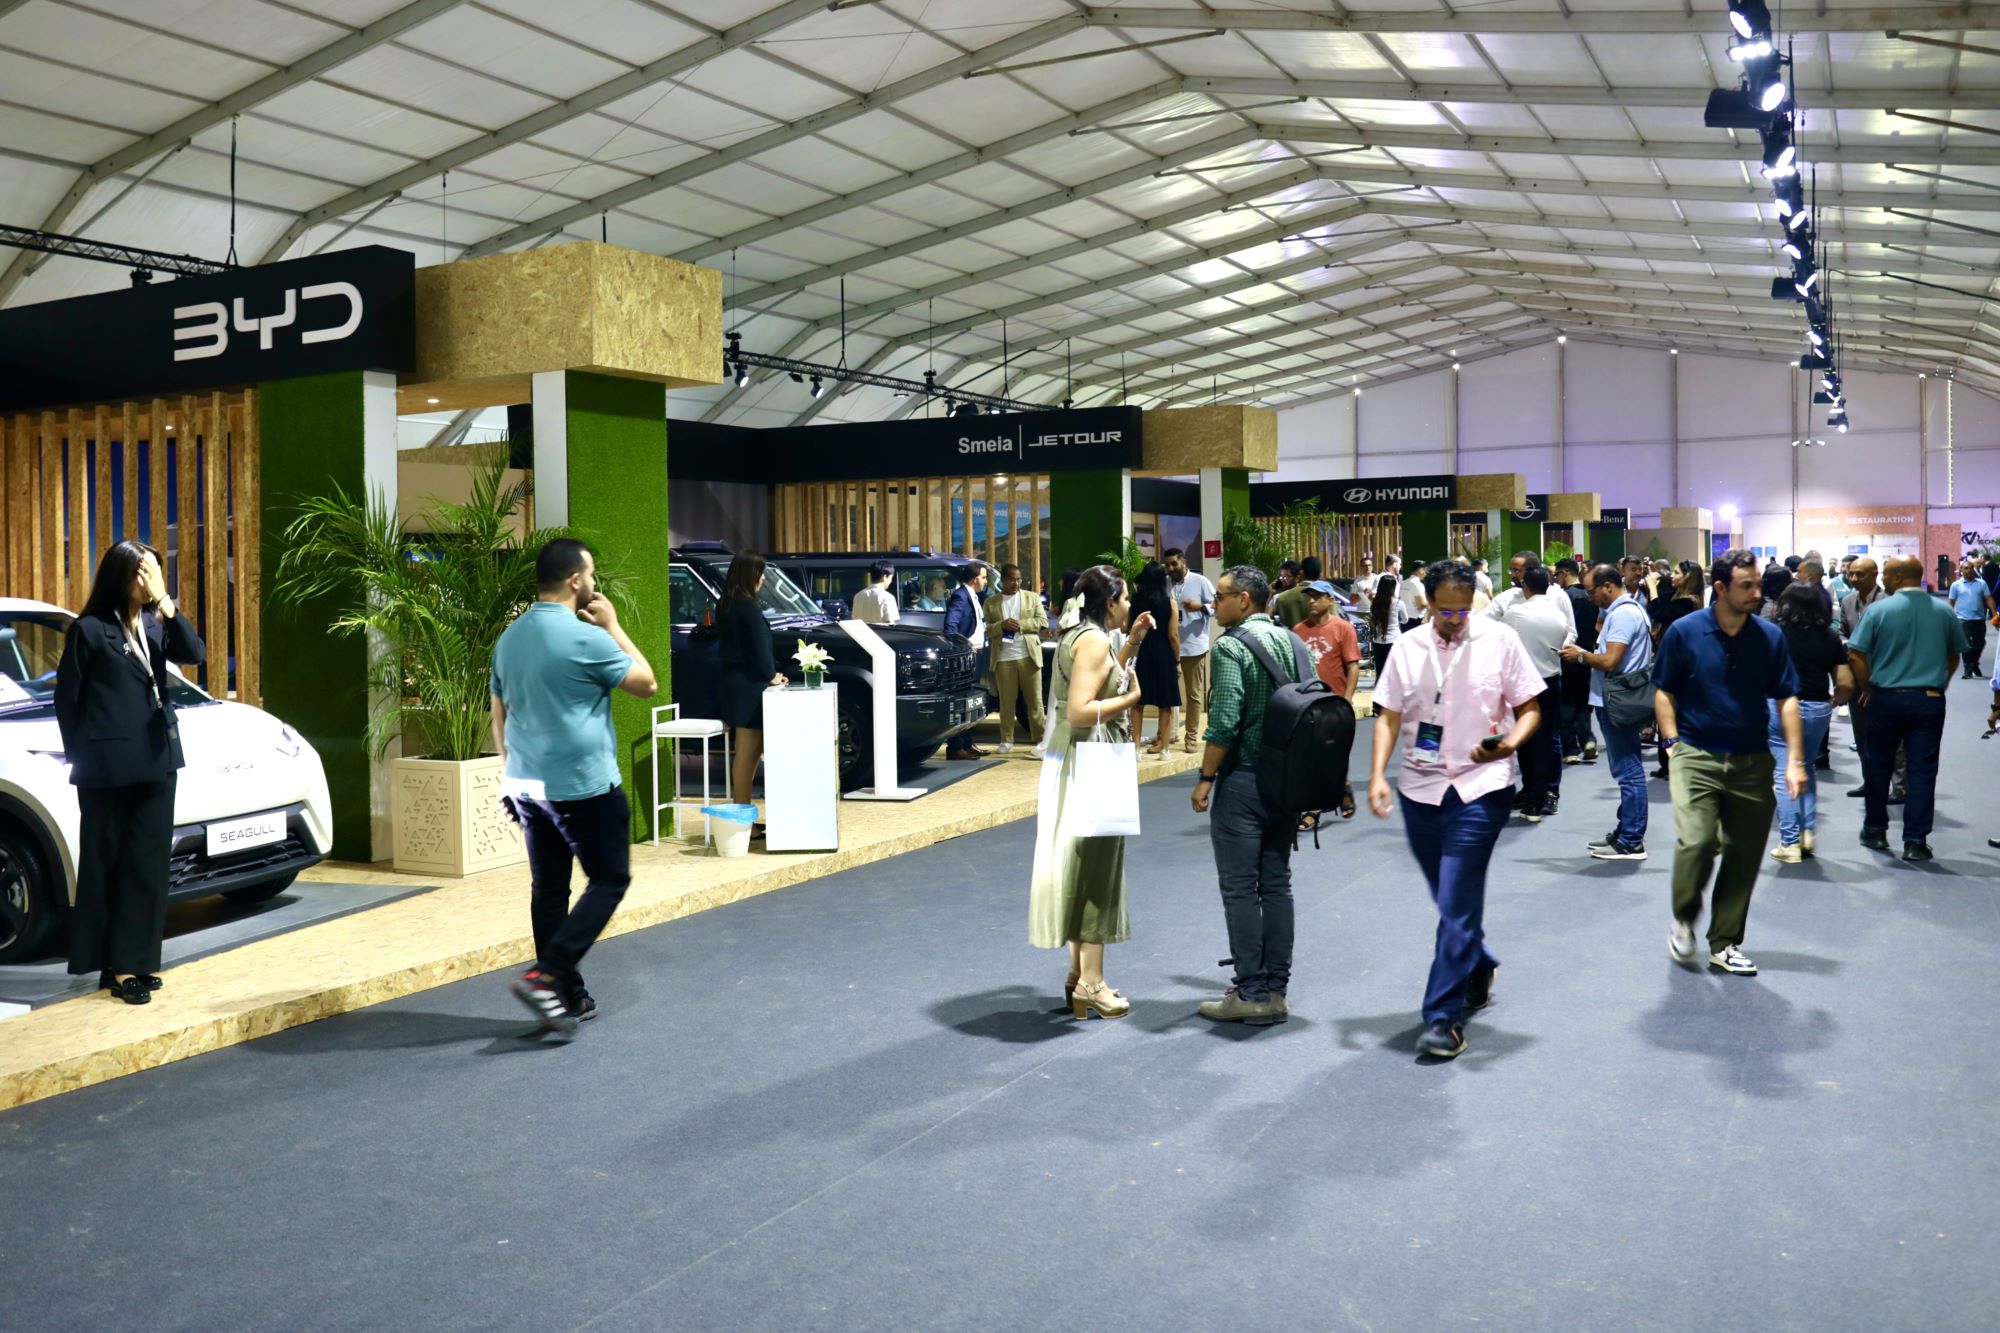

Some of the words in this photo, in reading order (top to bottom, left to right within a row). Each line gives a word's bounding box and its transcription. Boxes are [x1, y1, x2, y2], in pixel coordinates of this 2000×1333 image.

[174, 281, 363, 361] BYD
[958, 436, 1013, 453] Smeia
[1028, 431, 1122, 447] JETOUR
[1375, 486, 1449, 501] HYUNDAI
[1846, 516, 1914, 526] RESTAURATION
[220, 824, 276, 843] SEAGULL
